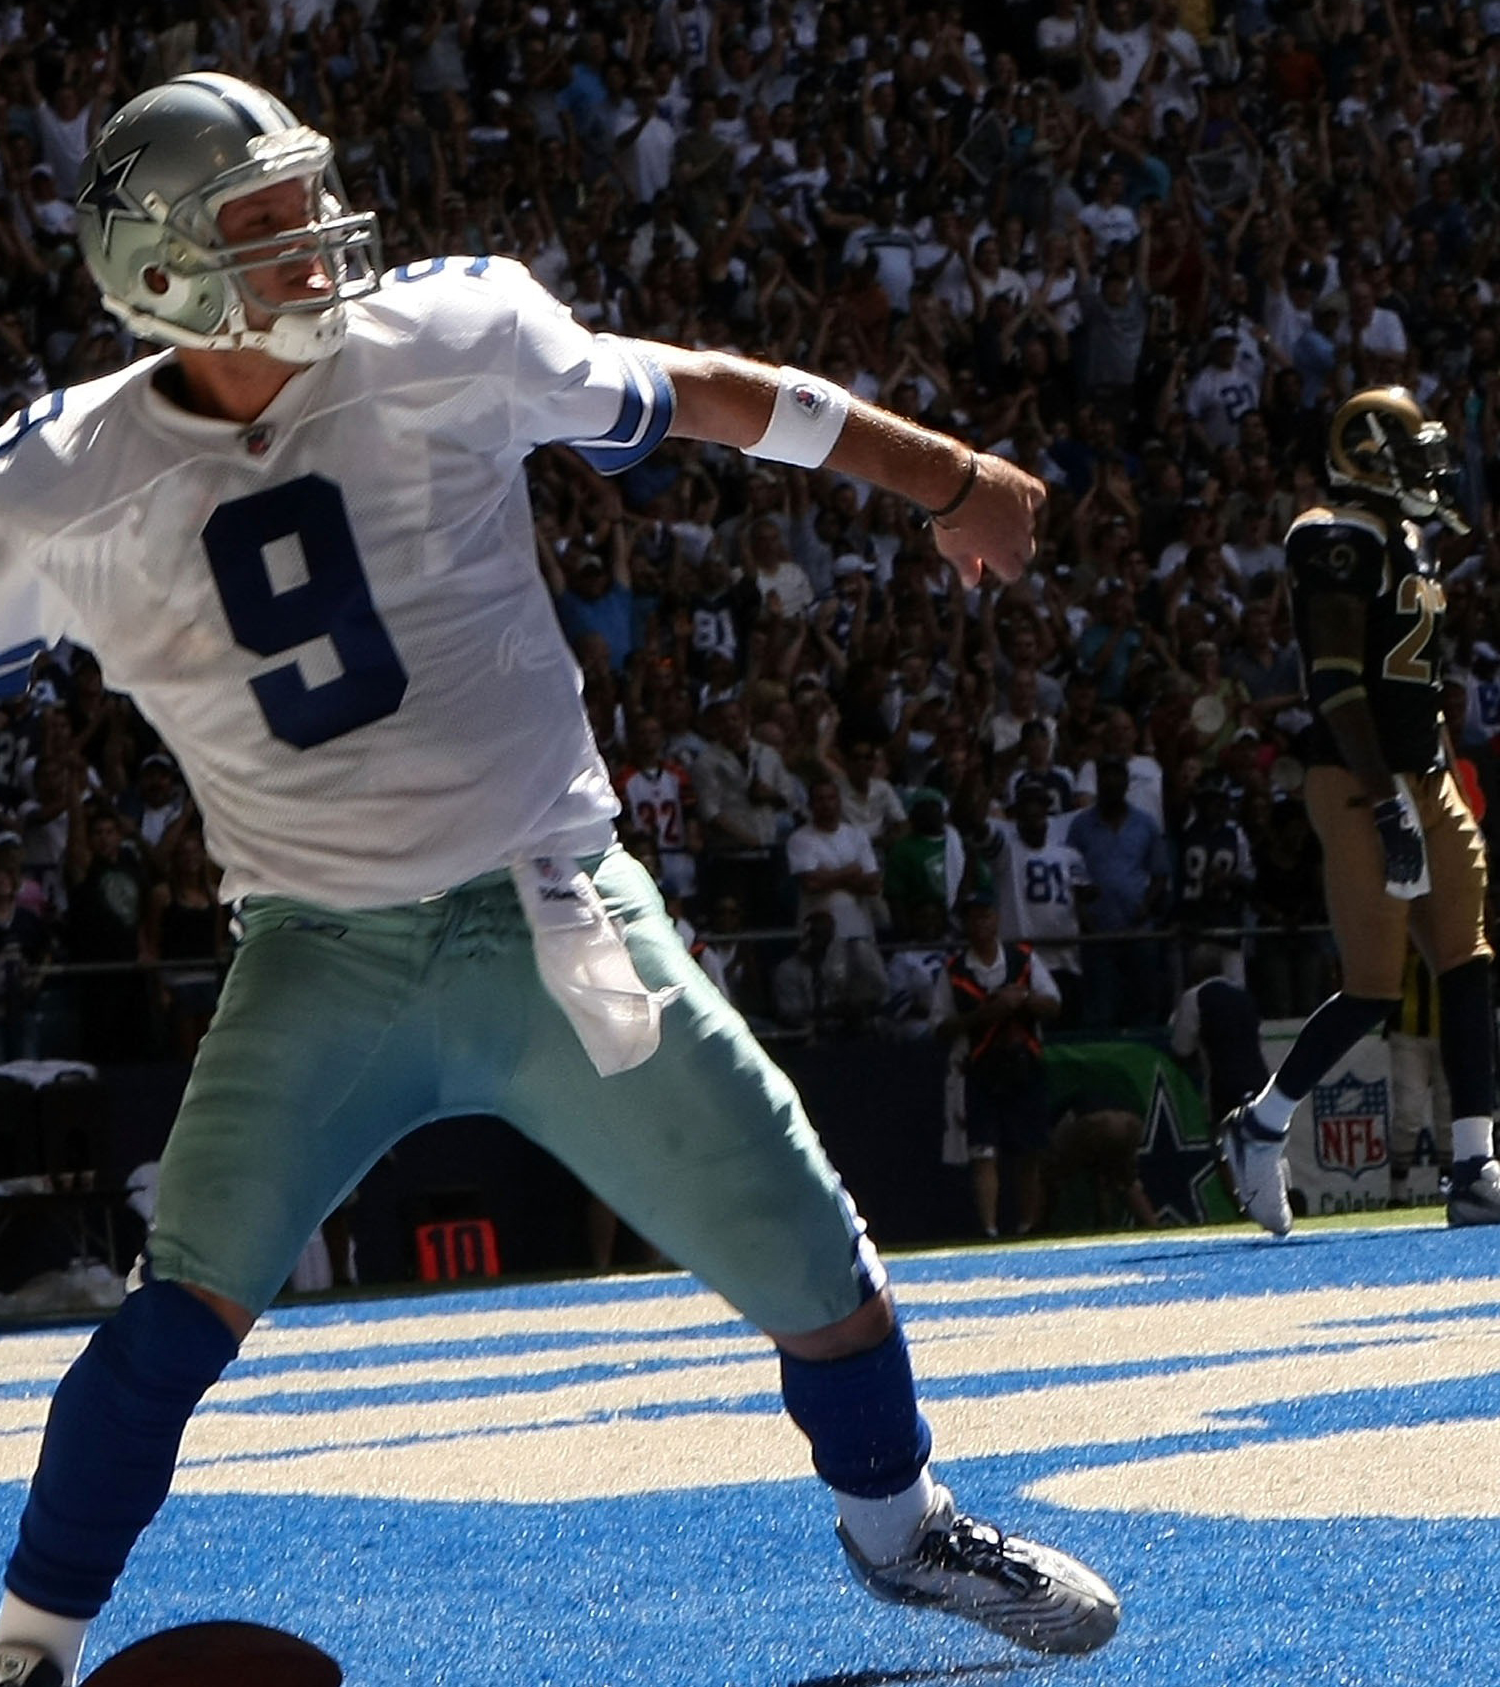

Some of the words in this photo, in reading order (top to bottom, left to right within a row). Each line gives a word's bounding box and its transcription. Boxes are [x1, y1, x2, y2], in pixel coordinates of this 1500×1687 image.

[202, 473, 408, 751] 9
[1382, 573, 1447, 686] 2
[1026, 859, 1068, 905] 81
[1321, 1118, 1385, 1169] NFL
[427, 1225, 484, 1280] 10
